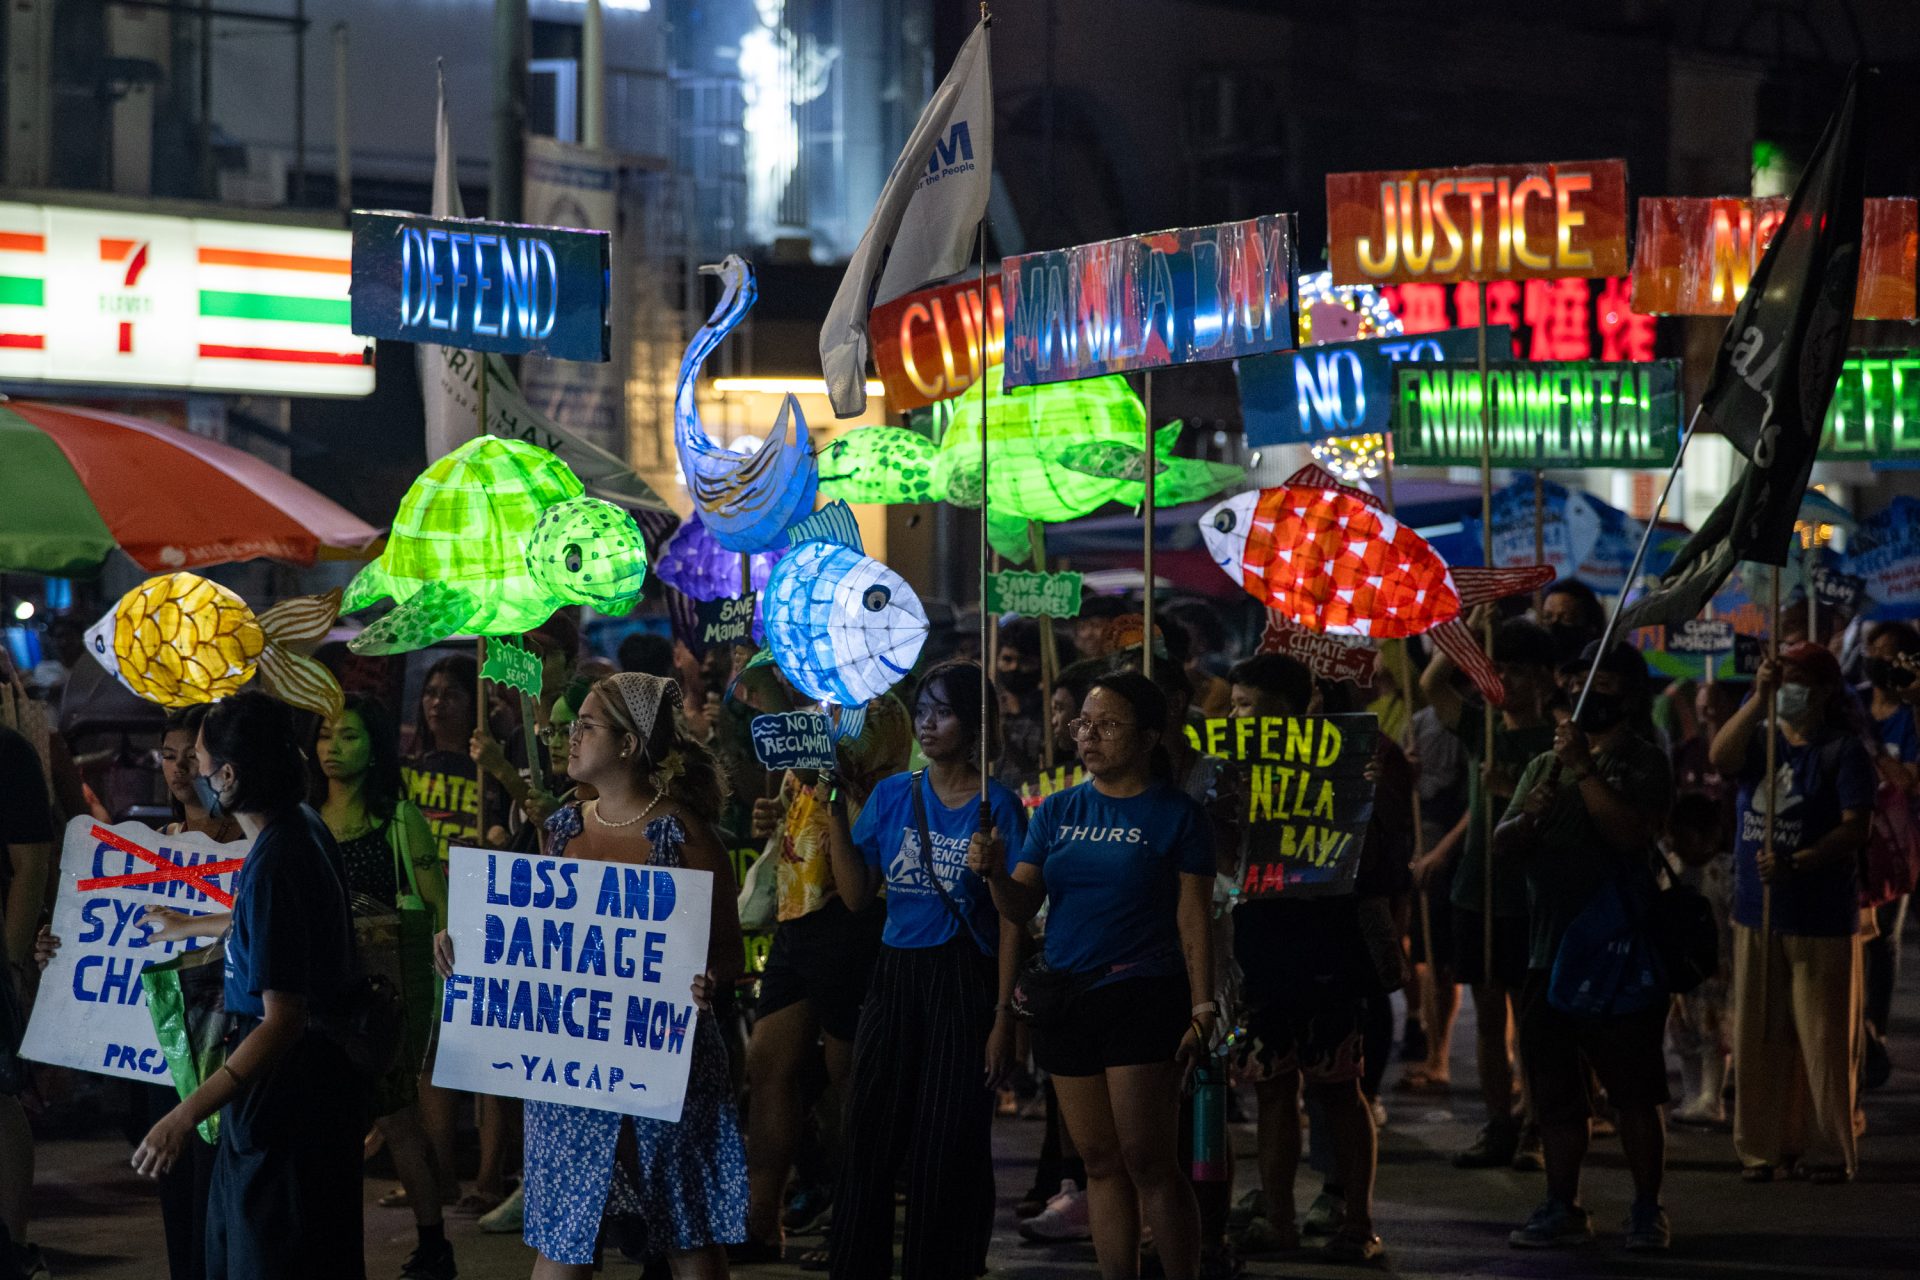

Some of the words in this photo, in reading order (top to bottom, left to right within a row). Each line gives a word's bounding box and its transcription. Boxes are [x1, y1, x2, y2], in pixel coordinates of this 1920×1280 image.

[925, 174, 940, 186] the
[941, 162, 975, 178] People
[1356, 172, 1594, 276] JUSTICE
[99, 238, 148, 353] 7
[401, 227, 558, 340] DEFEND
[1011, 247, 1176, 374] MANILA
[1191, 229, 1281, 352] BAY
[900, 277, 1006, 399] CLIM
[1293, 349, 1367, 435] NO
[1400, 369, 1666, 460] ENVIRONMENTAL
[719, 594, 754, 622] SAVE
[995, 575, 1041, 594] SAVE
[1042, 579, 1073, 597] OUR
[1000, 593, 1070, 613] SHORES
[496, 648, 519, 667] SAVE
[522, 657, 537, 677] OUR
[505, 664, 530, 685] SEAS!
[1289, 633, 1347, 661] CLIMATE
[786, 717, 808, 731] NO
[809, 715, 824, 734] TO
[1249, 764, 1334, 824] NILA
[1058, 824, 1149, 845] THURS.
[1279, 824, 1353, 868] BAY!
[486, 854, 579, 911] LOSS
[595, 865, 677, 922] AND
[483, 913, 667, 984] DAMAGE
[442, 973, 613, 1042] FINANCE
[623, 995, 693, 1055] NOW
